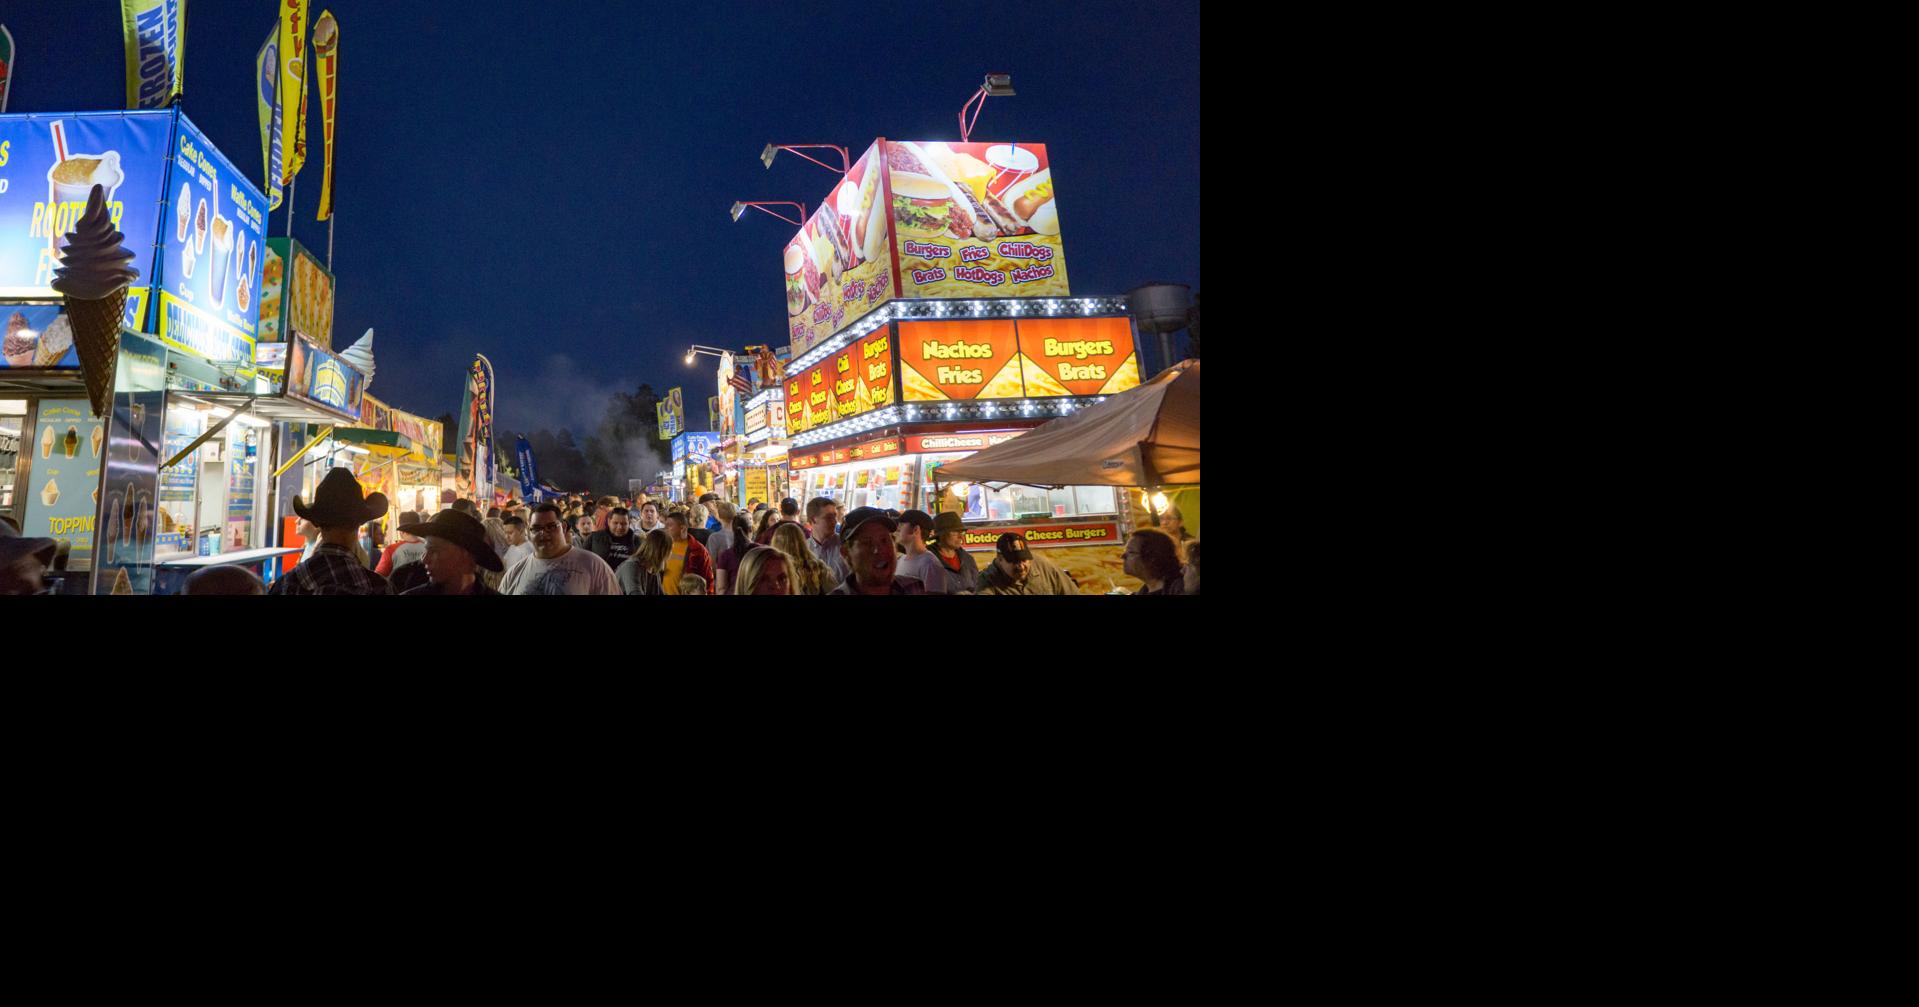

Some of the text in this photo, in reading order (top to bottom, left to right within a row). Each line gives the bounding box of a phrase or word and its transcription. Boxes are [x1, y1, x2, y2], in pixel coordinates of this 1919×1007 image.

[30, 201, 123, 238] ROOTR
[905, 241, 1053, 261] Burgers Fries ChiliDogs
[913, 265, 1054, 285] Brats HotDogs Nachos
[863, 336, 888, 360] Burgers
[922, 340, 993, 360] Nachos
[1043, 338, 1114, 360] Burgers
[868, 361, 887, 382] Brats
[937, 365, 983, 385] Fries
[1057, 362, 1107, 381] Brats
[836, 378, 855, 396] Cheese
[871, 385, 888, 404] Fries
[965, 528, 1107, 544] Hotdo Cheese Burgers
